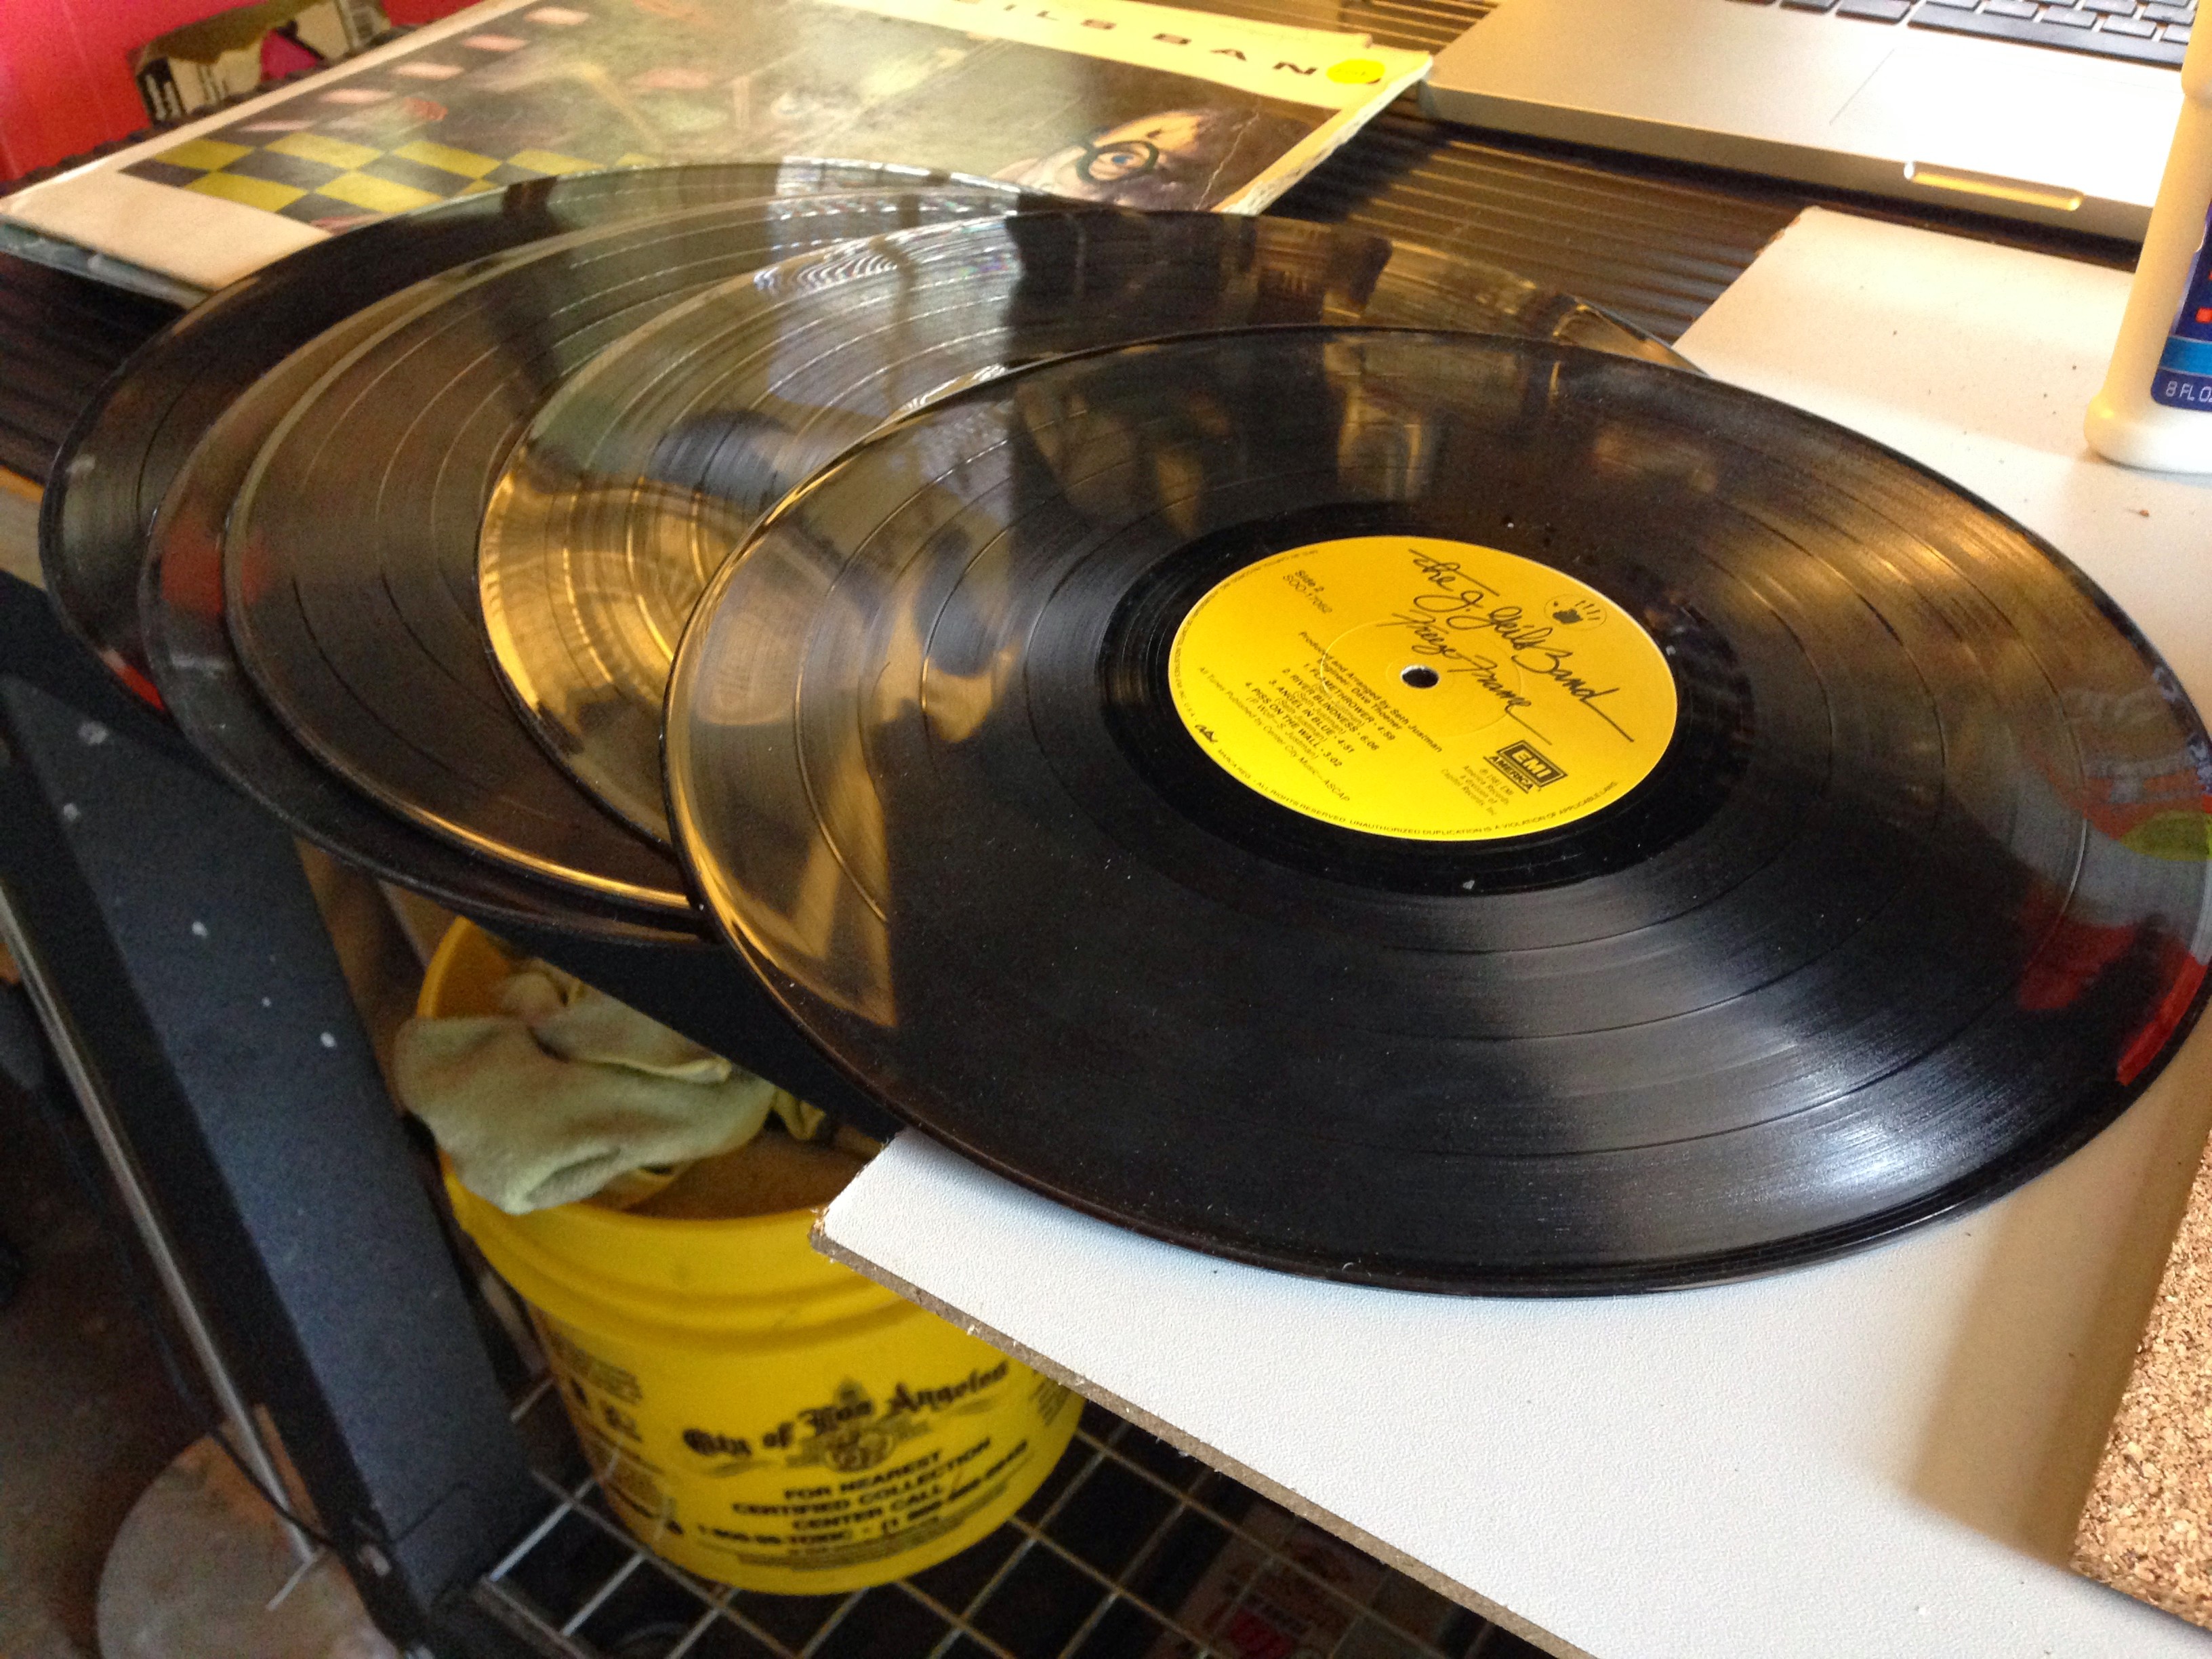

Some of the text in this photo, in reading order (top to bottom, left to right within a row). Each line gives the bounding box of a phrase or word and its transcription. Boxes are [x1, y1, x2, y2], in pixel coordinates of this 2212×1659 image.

[2165, 380, 2178, 397] 8
[2179, 382, 2195, 402] FL
[1293, 569, 1317, 587] Side
[1408, 548, 1635, 743] The J. Geils Band
[1205, 673, 1228, 691] Tunes
[1309, 667, 1375, 722] FLAMETHROWER
[1350, 687, 1372, 703] Dave
[1375, 608, 1553, 745] Freeze Frame
[1250, 687, 1273, 703] PISS
[1267, 703, 1285, 715] ON
[1281, 714, 1301, 729] THE
[1296, 728, 1322, 748] WALL
[1275, 686, 1304, 708] ANGEL
[1309, 716, 1336, 736] BLUE
[1289, 674, 1316, 695] RIVER
[1311, 694, 1359, 732] BLINDNESS
[1330, 659, 1349, 672] and
[1345, 672, 1382, 701] Arranged
[1389, 708, 1410, 725] Seth
[1407, 724, 1443, 752] Justman
[1491, 755, 1534, 790] AMERICA
[1511, 749, 1553, 779] EMI
[762, 1421, 794, 1449] of
[886, 1360, 1009, 1415] Angeles
[784, 1449, 940, 1500] FOR NEAREST
[858, 1435, 991, 1506] COLLECTION
[792, 1507, 883, 1530] CENTER
[890, 1483, 941, 1513] CALL
